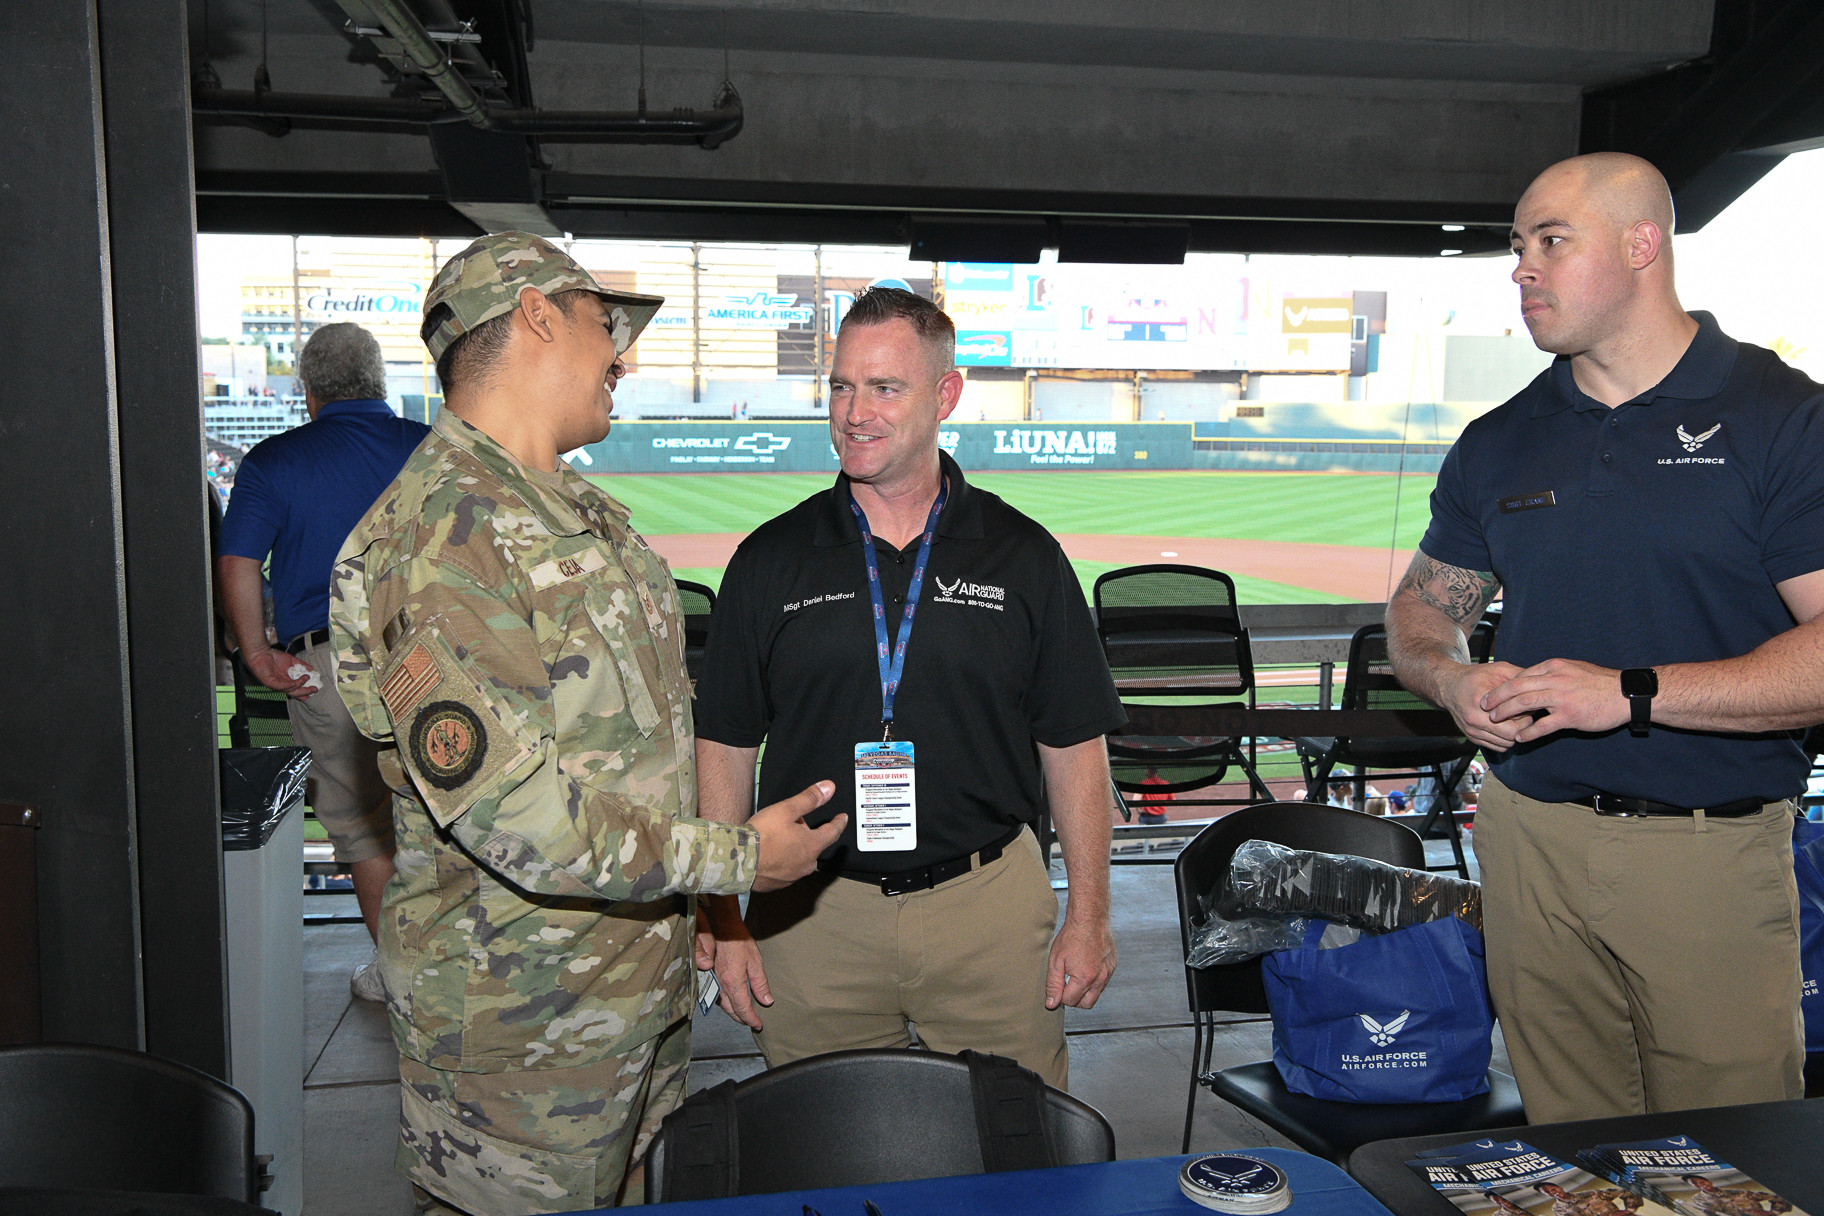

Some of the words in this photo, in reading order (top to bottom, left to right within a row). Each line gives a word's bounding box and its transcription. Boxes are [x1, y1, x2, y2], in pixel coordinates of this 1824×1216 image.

[707, 308, 769, 321] AMERICA
[771, 309, 812, 322] FIRST
[652, 438, 731, 448] CHEVROLET
[993, 429, 1096, 454] LiUNA!
[1030, 454, 1047, 464] Feel
[1049, 454, 1062, 464] the
[1064, 454, 1095, 464] Power!
[1691, 457, 1726, 465] FORCE
[558, 558, 586, 578] CEJA
[958, 582, 981, 598] AIR
[980, 584, 1006, 595] NATIONAL
[980, 590, 1005, 601] GUARD
[783, 601, 801, 612] MSgt
[803, 595, 823, 607] Daniel
[825, 591, 855, 602] Bedford
[933, 596, 966, 605] GoANG.com
[1341, 1054, 1363, 1063] U.S.
[1364, 1054, 1384, 1062] AIR
[1385, 1052, 1427, 1060] FORCE
[1341, 1061, 1427, 1070] AIRFORCE.COM
[1618, 1149, 1659, 1157] UNITED
[1660, 1148, 1702, 1157] STATES
[1466, 1159, 1502, 1172] UNITED
[1503, 1152, 1541, 1166] STATES
[1621, 1155, 1654, 1166] AIR
[1655, 1153, 1716, 1166] FORCE
[1470, 1167, 1503, 1181] AIR
[1503, 1156, 1557, 1178] FORCE
[1637, 1165, 1686, 1173] MECHANICAL
[1428, 1173, 1459, 1182] AIR
[1490, 1174, 1533, 1187] MECHANICAL
[1533, 1166, 1564, 1178] CAREERS
